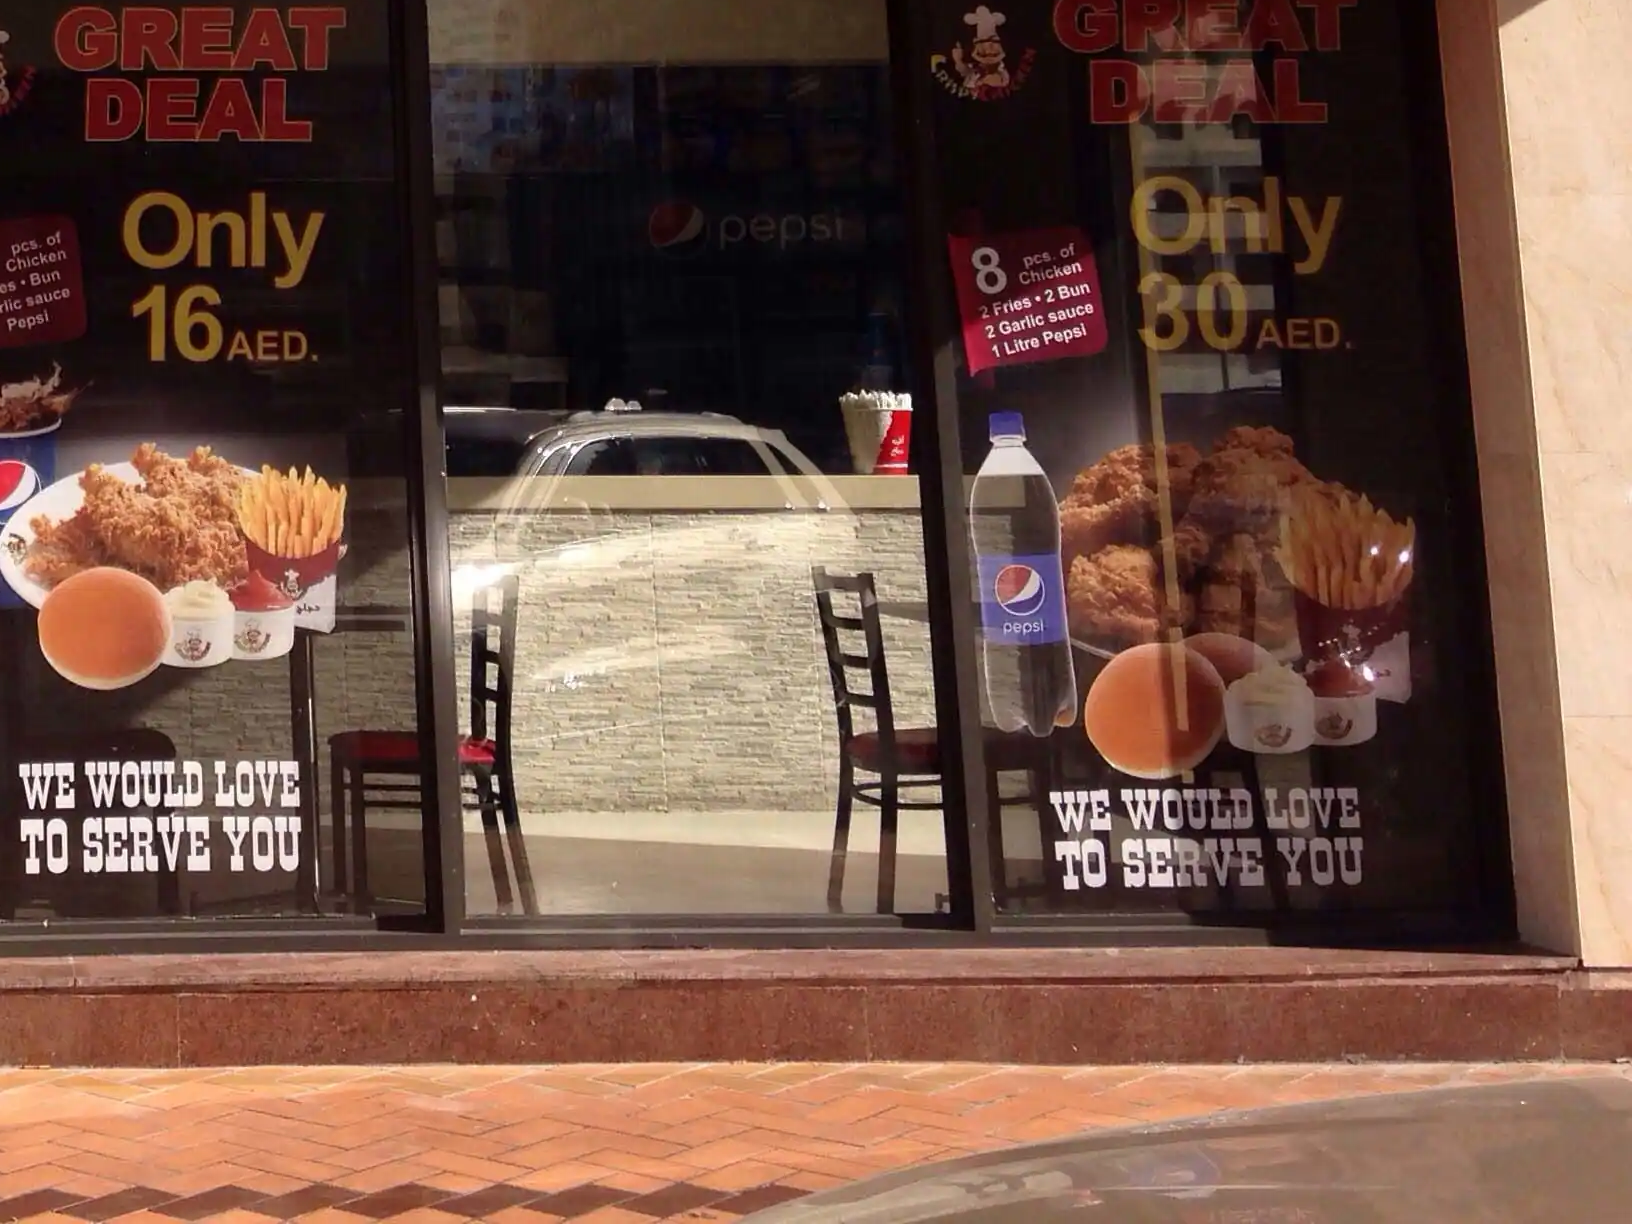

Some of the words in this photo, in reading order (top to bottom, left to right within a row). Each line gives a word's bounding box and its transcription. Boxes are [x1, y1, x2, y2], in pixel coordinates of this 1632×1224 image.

[54, 7, 346, 72] GREAT
[85, 78, 313, 142] DEAL
[1090, 59, 1328, 124] DEAL
[11, 239, 43, 256] pcs.
[46, 231, 62, 246] of
[123, 192, 325, 289] Only
[720, 213, 844, 251] pepsi
[1130, 176, 1342, 275] Only
[6, 249, 67, 272] Chicken
[971, 247, 1008, 294] 8
[1018, 261, 1083, 285] Chicken
[1023, 251, 1056, 269] pcs.
[1060, 243, 1076, 258] of
[25, 288, 70, 307] sauce
[29, 270, 61, 286] Bun
[7, 309, 49, 331] Pepsi
[979, 304, 990, 319] 2
[993, 297, 1032, 316] Fries
[1044, 288, 1056, 303] 2
[1058, 283, 1091, 300] Bun
[985, 324, 997, 339] 2
[999, 314, 1045, 335] Garlic
[1048, 303, 1095, 323] sauce
[1137, 272, 1248, 352] 30
[1256, 318, 1355, 352] AED.
[132, 284, 223, 363] 16
[226, 330, 319, 363] AED.
[992, 344, 1001, 357] 1
[1004, 336, 1040, 356] Litre
[1042, 323, 1087, 345] Pepsi
[1003, 618, 1045, 636] pepsi
[19, 762, 75, 810] WE
[84, 761, 204, 809] WOULD
[215, 760, 301, 808] LOVE
[1050, 788, 1112, 833] WE
[1121, 788, 1255, 831] WOULD
[1267, 787, 1361, 830] LOVE
[20, 818, 70, 875] TO
[82, 816, 211, 874] SERVE
[223, 816, 302, 872] YOU
[1055, 838, 1108, 890] TO
[1121, 837, 1265, 889] SERVE
[1276, 836, 1365, 887] YOU
